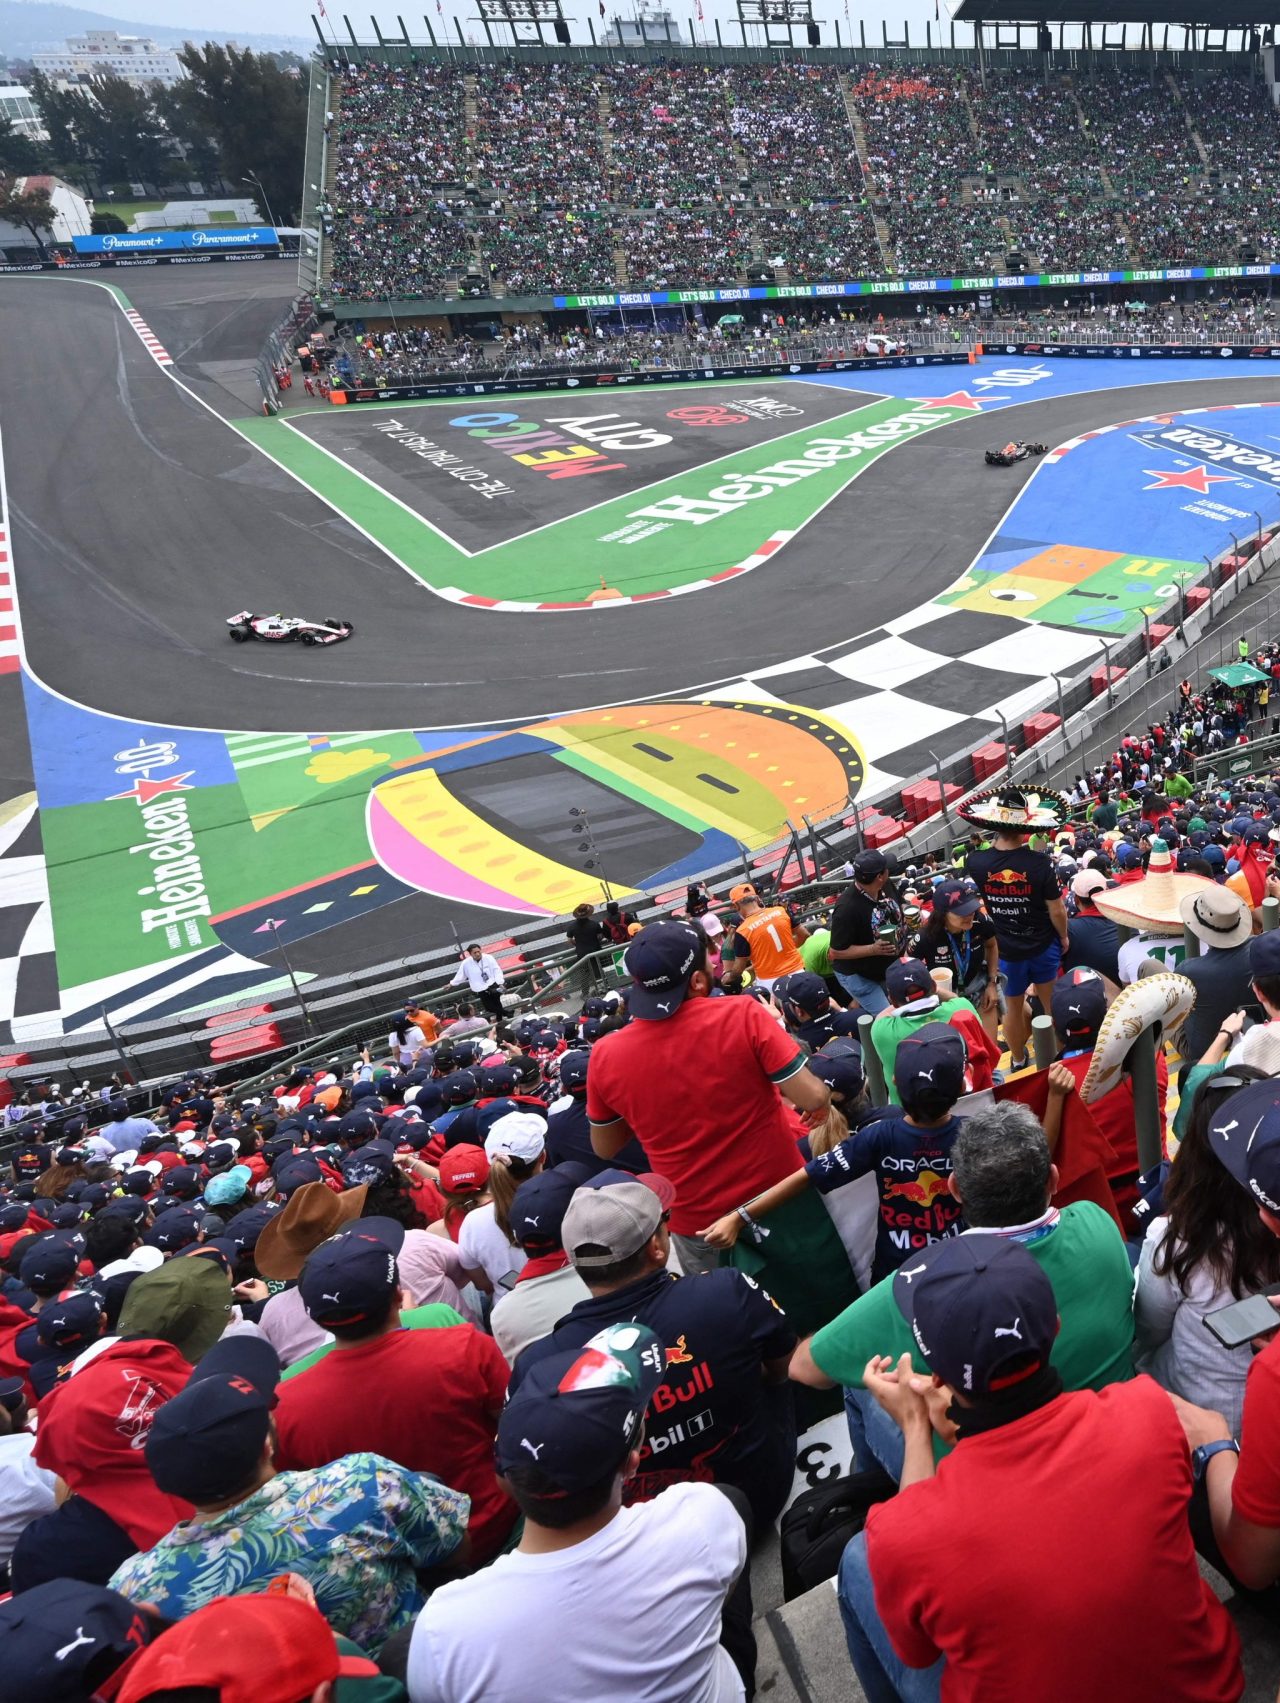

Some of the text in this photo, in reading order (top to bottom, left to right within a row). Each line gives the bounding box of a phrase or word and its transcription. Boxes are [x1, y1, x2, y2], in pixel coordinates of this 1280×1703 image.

[102, 235, 164, 250] Paramount+
[371, 419, 409, 433] ALL
[544, 414, 674, 450] CITY
[398, 435, 439, 452] HAS
[449, 412, 628, 480] MEXICO
[416, 450, 464, 468] THAT
[625, 408, 951, 525] Heineken
[443, 466, 489, 482] CITY
[468, 479, 516, 499] THE
[128, 797, 212, 934] Heineken
[984, 884, 1032, 896] Red Bull
[987, 895, 1030, 903] HONDA
[991, 907, 1020, 915] Mobil
[766, 923, 783, 953] 1
[881, 1156, 954, 1172] ORACL
[652, 1361, 714, 1413] Bull
